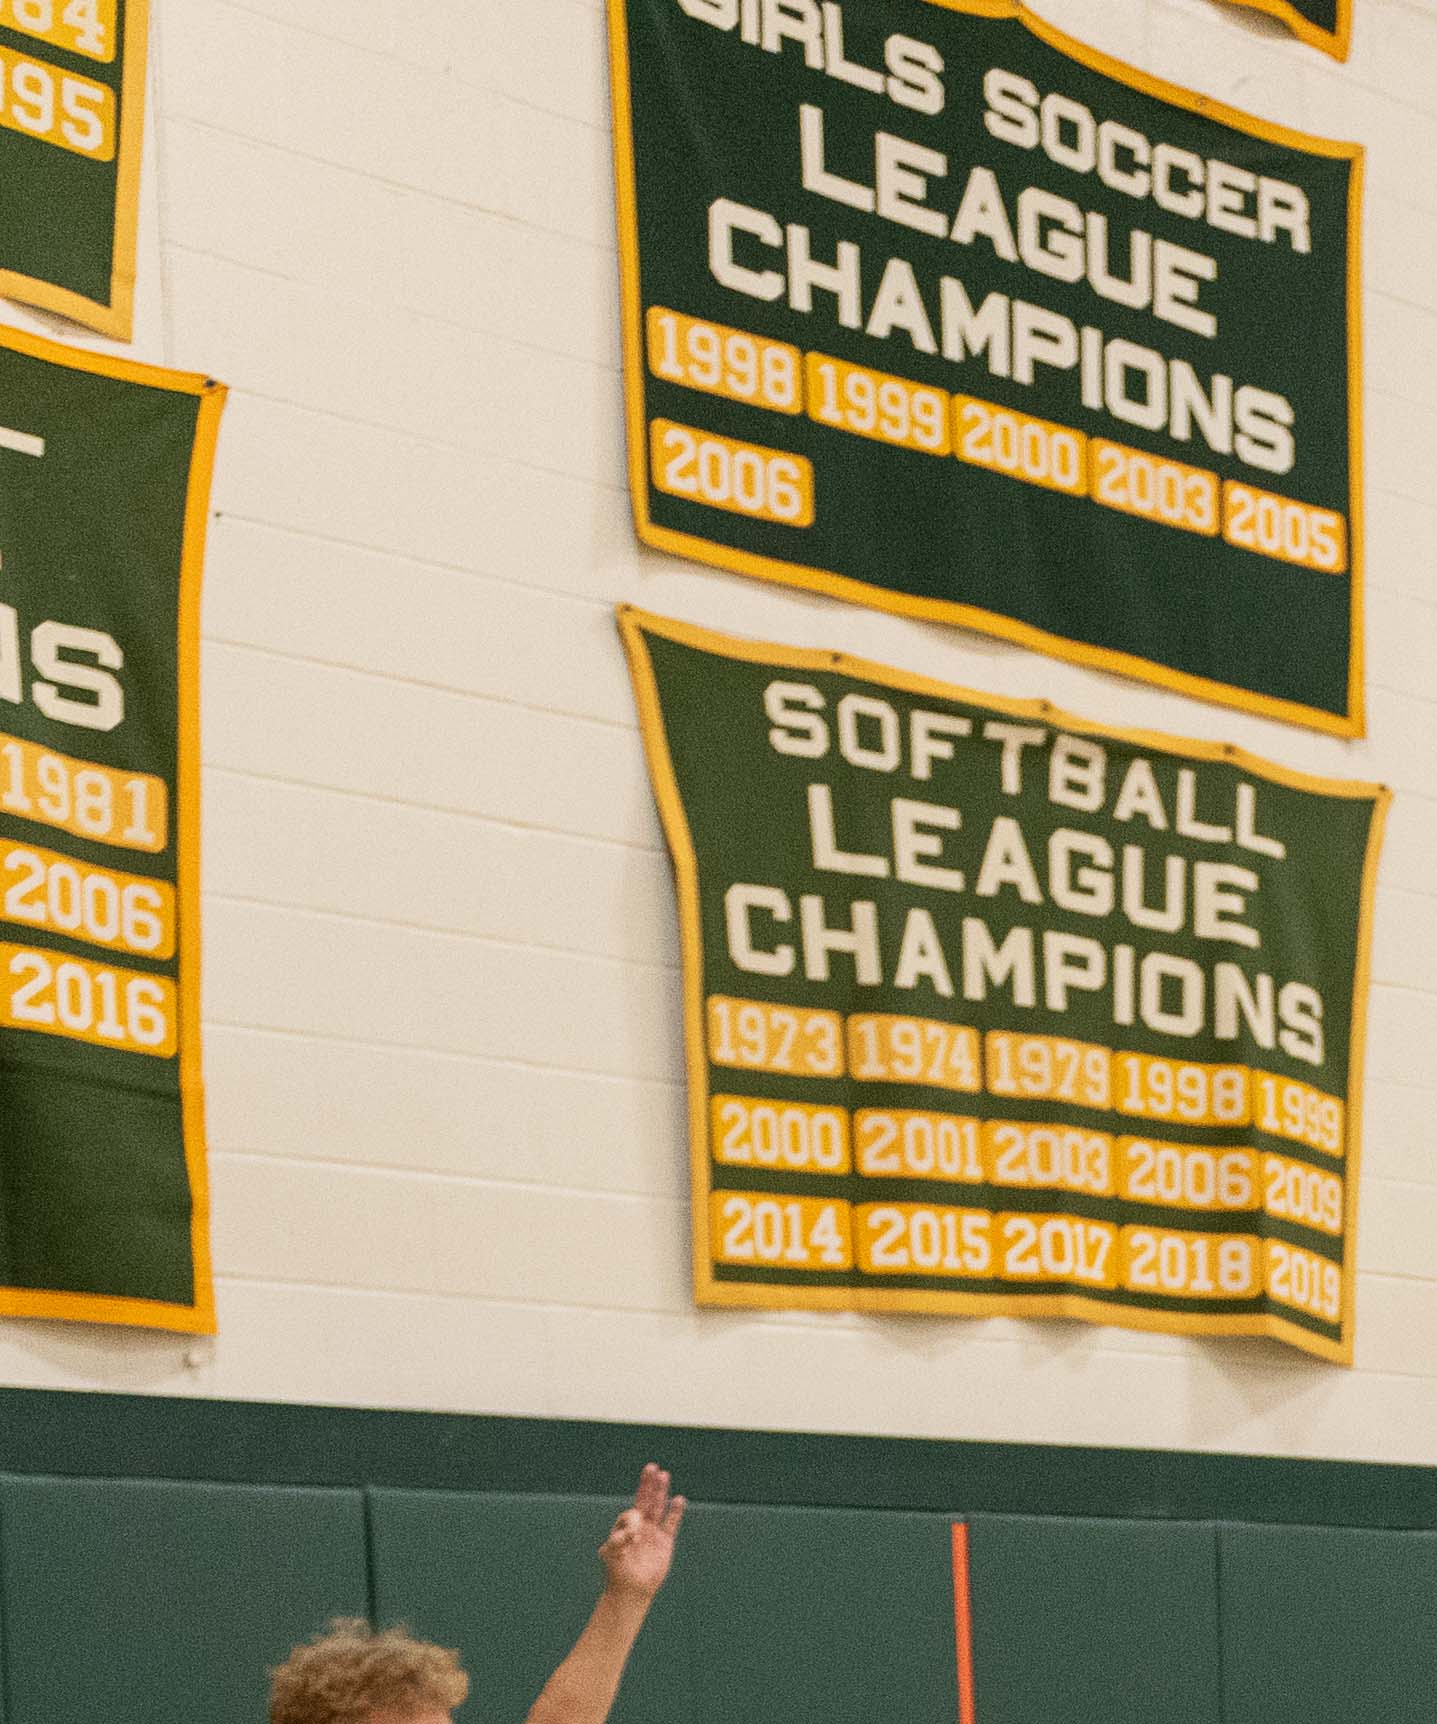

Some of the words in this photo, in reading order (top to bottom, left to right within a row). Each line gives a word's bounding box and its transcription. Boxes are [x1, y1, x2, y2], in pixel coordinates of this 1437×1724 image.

[0, 59, 104, 151] 95
[982, 67, 1312, 254] SOCCER
[799, 102, 1218, 338] LEAGUE
[707, 197, 1296, 475] CHAMPIONS
[656, 314, 802, 412] 1998
[813, 362, 949, 446] 1999
[961, 402, 1082, 490] 2000
[1098, 450, 1217, 533] 2003
[1231, 490, 1340, 569] 2005
[661, 431, 803, 524] 2006
[2, 741, 155, 844] 1981
[763, 680, 1286, 860] SOFTBALL
[4, 848, 161, 949] 2006
[806, 783, 1262, 949] LEAGUE
[9, 950, 166, 1045] 2016
[723, 882, 1326, 1067] CHAMPIONS
[714, 1001, 838, 1073] 1973
[858, 1018, 978, 1085] 1974
[993, 1036, 1111, 1104] 1979
[1124, 1058, 1245, 1121] 1998
[1262, 1078, 1340, 1151] 1999
[720, 1102, 843, 1168] 2000
[862, 1114, 982, 1178] 2001
[994, 1126, 1110, 1193] 2003
[1126, 1143, 1252, 1206] 2006
[1263, 1155, 1342, 1231] 2009
[723, 1196, 845, 1264] 2014
[867, 1207, 992, 1270] 2015
[1002, 1218, 1112, 1281] 2017
[1130, 1232, 1252, 1294] 2018
[1268, 1245, 1341, 1317] 2019
